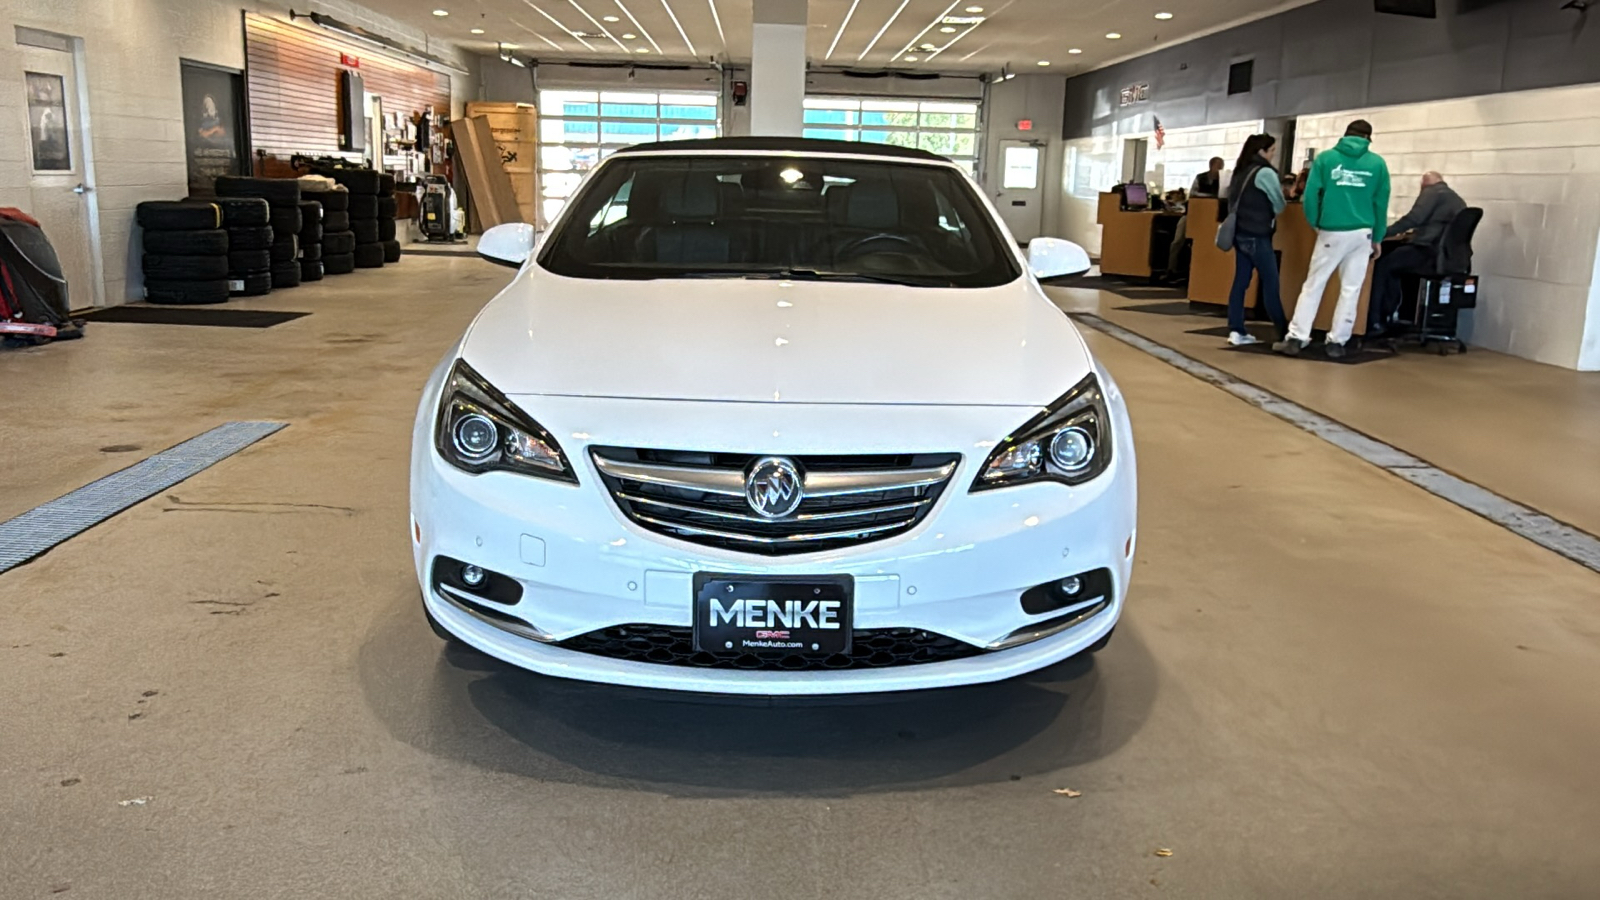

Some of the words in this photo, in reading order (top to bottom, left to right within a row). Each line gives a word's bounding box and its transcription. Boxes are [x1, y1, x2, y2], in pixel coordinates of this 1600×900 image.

[709, 598, 841, 629] MENKE
[755, 630, 791, 639] GMC
[742, 639, 803, 649] MenkeAuto.com
